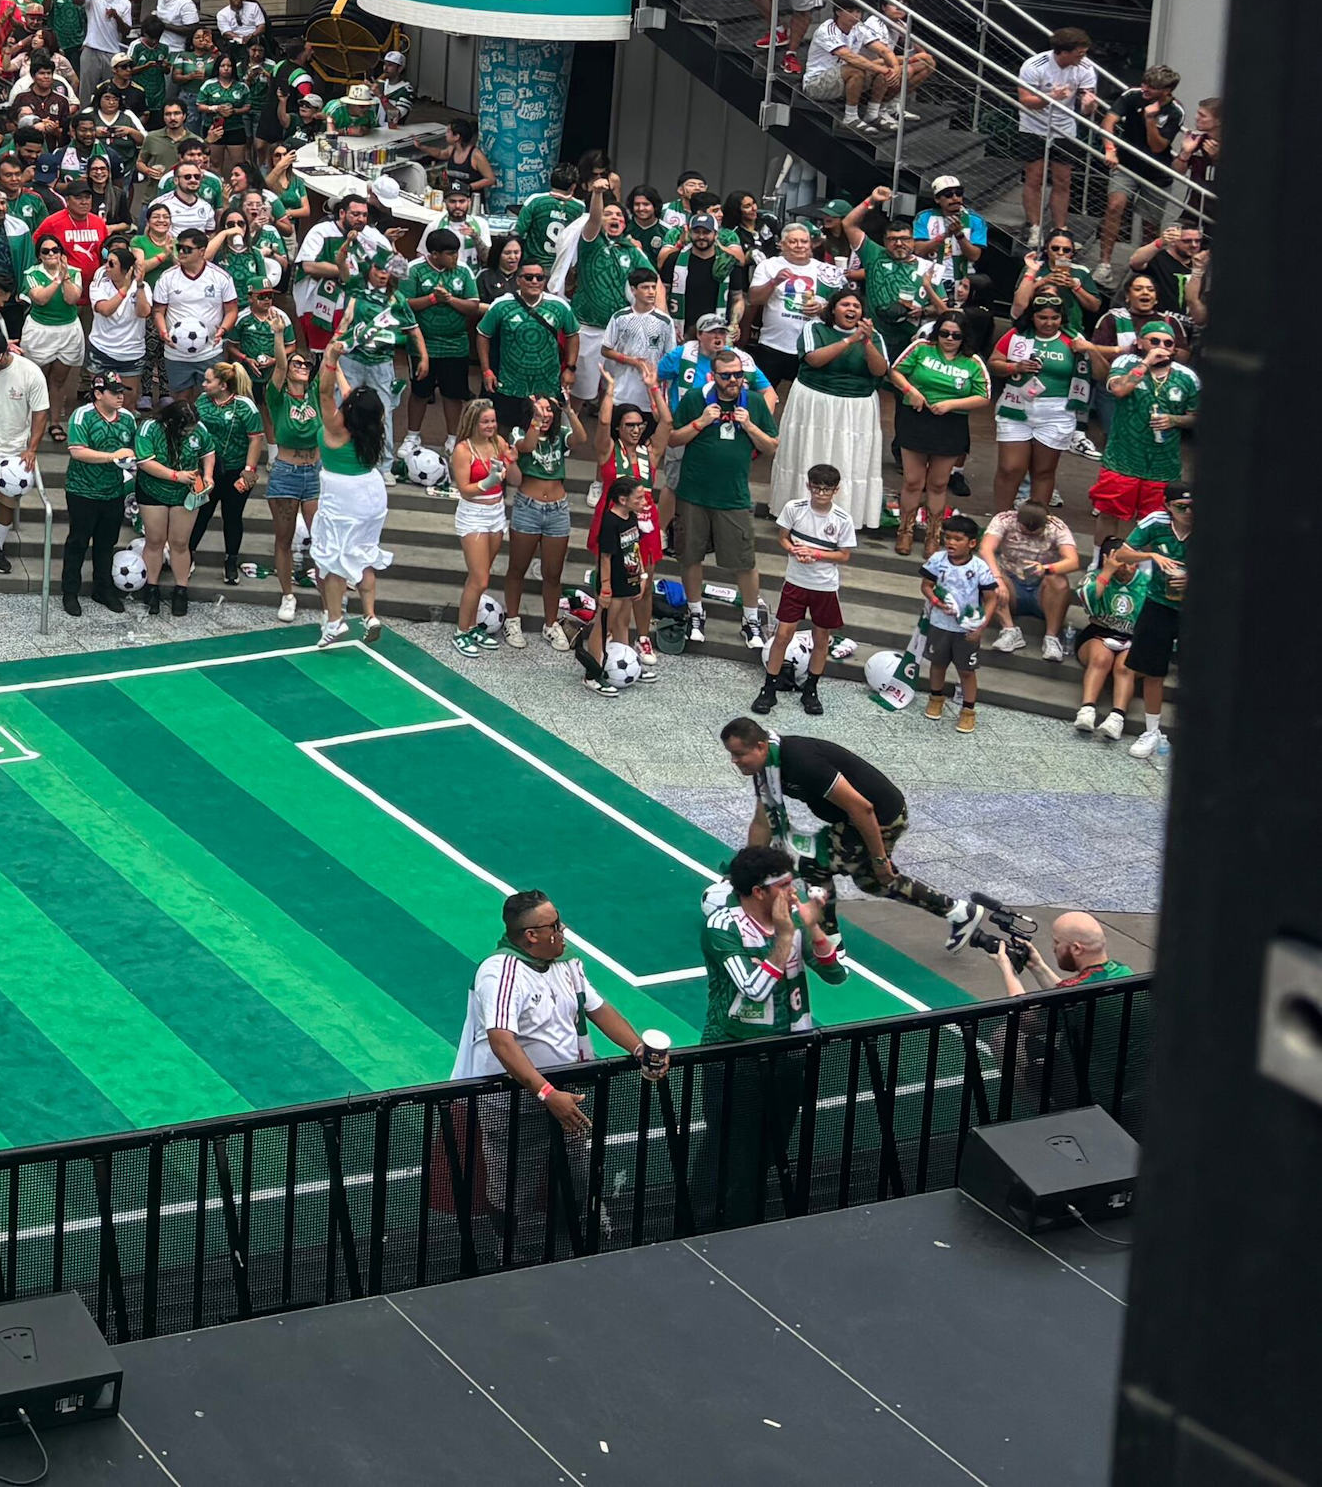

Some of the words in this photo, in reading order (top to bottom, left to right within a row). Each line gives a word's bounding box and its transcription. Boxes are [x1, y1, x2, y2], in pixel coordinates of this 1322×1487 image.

[64, 229, 100, 243] PUMA
[323, 280, 335, 294] 6
[922, 357, 970, 379] MEXICO
[789, 986, 802, 1011] 6
